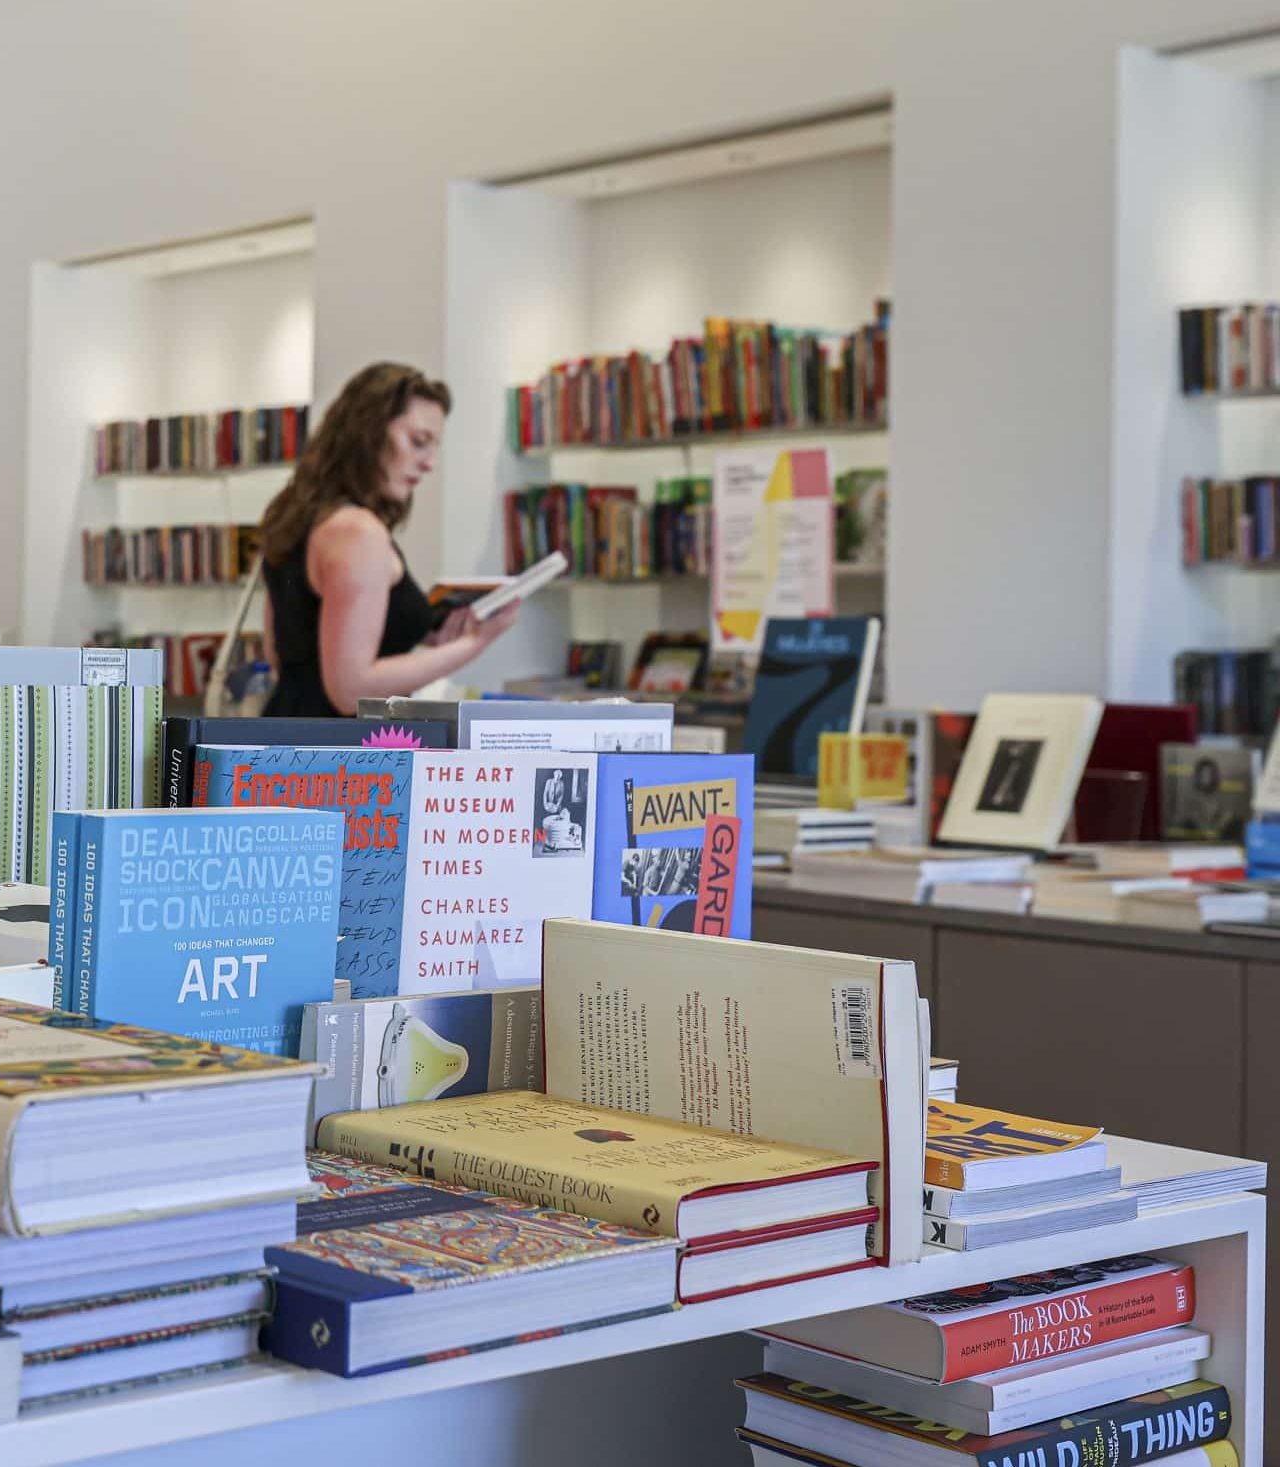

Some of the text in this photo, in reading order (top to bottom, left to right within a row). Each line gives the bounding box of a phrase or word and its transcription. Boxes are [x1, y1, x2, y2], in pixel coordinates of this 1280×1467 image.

[233, 764, 394, 808] Encounters
[425, 767, 514, 782] THE ART
[425, 798, 515, 813] MUSEUM
[624, 781, 633, 812] THE
[640, 788, 730, 826] AVANT-
[120, 824, 336, 858] DEALING COLLAGE
[344, 808, 399, 851] ists
[424, 827, 548, 844] IN MODERN
[86, 842, 96, 870] 100
[422, 860, 483, 875] TIMES
[120, 855, 334, 891] SHOCK CANVAS
[83, 874, 95, 923] IDEAS
[213, 890, 332, 906] GLOBALISATION
[421, 898, 509, 915] CHARLES
[53, 840, 67, 1010] 100 IDEAS THAT CHAN
[118, 896, 211, 933] ICON
[212, 905, 331, 928] LANDSCAPE
[81, 927, 92, 966] THAT
[173, 936, 275, 951] 100 IDEAS THAT CHANGED
[419, 928, 524, 946] SAUMAREZ
[177, 954, 268, 1004] ART
[418, 961, 479, 977] SMITH
[453, 1151, 616, 1204] THE OLDEST BOOK
[472, 1177, 509, 1196] THE
[1009, 1294, 1093, 1336] The BOOK
[1104, 1302, 1124, 1314] History
[961, 1337, 1007, 1357] ADAM SMYTH
[1009, 1323, 1093, 1364] MAKERS
[1095, 1425, 1104, 1467] AUGUIN
[1121, 1401, 1215, 1459] THING
